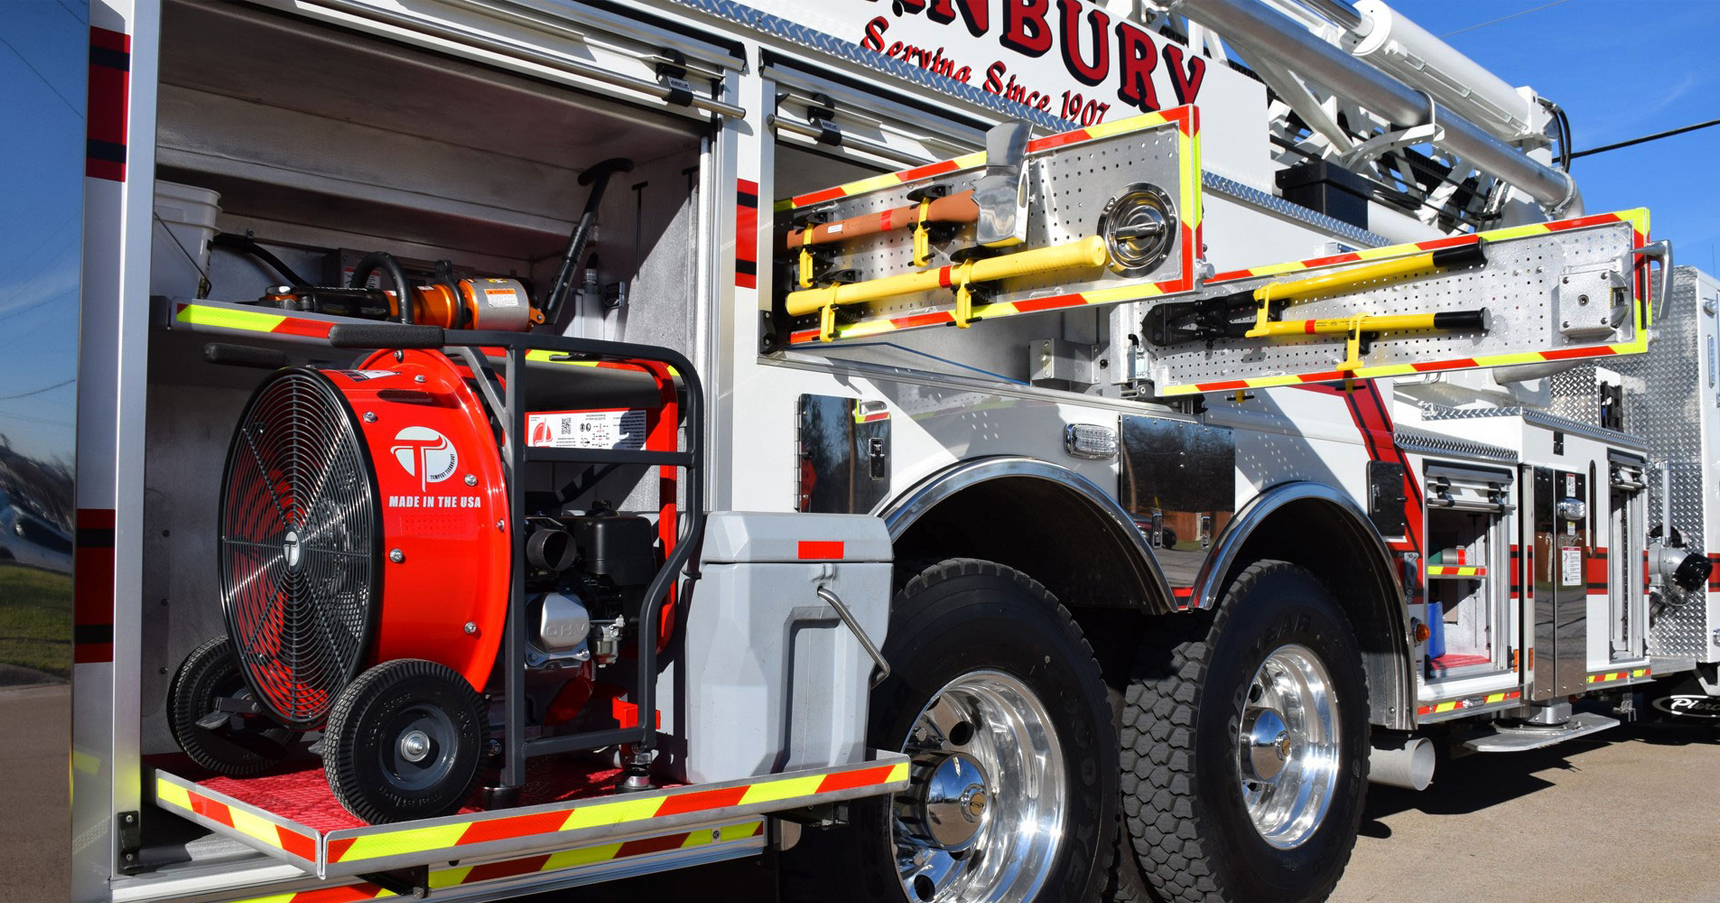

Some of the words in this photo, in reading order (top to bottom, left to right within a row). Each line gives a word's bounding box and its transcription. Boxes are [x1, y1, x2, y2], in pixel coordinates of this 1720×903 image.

[860, 16, 972, 83] Serving
[983, 60, 1051, 113] Since
[1060, 90, 1111, 127] 1907
[389, 495, 420, 508] MADE
[422, 495, 435, 508] IN
[438, 496, 457, 508] THE
[460, 496, 481, 508] USA
